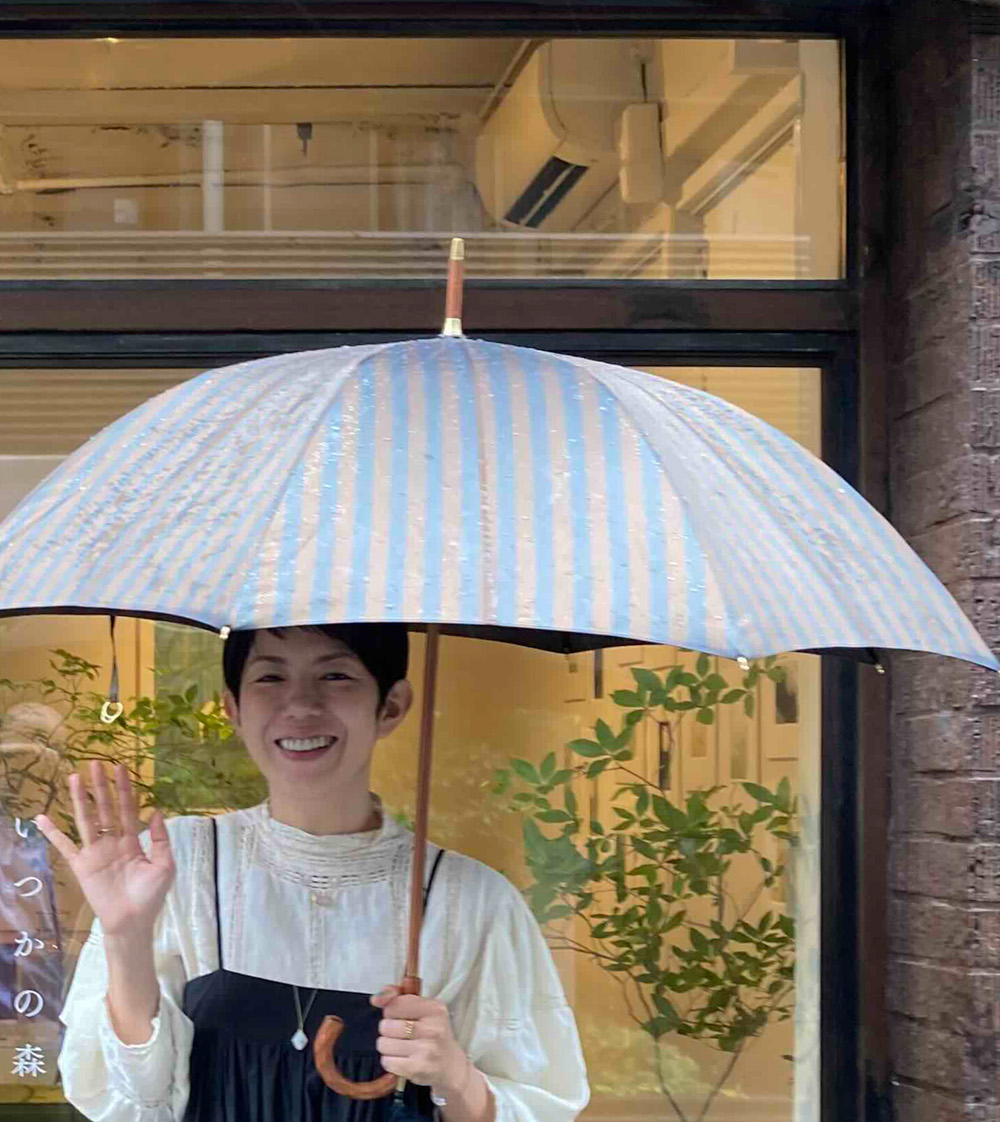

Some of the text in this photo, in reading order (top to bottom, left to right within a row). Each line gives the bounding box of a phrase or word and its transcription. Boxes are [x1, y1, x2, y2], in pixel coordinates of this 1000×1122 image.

[12, 816, 47, 1078] いつかの森
